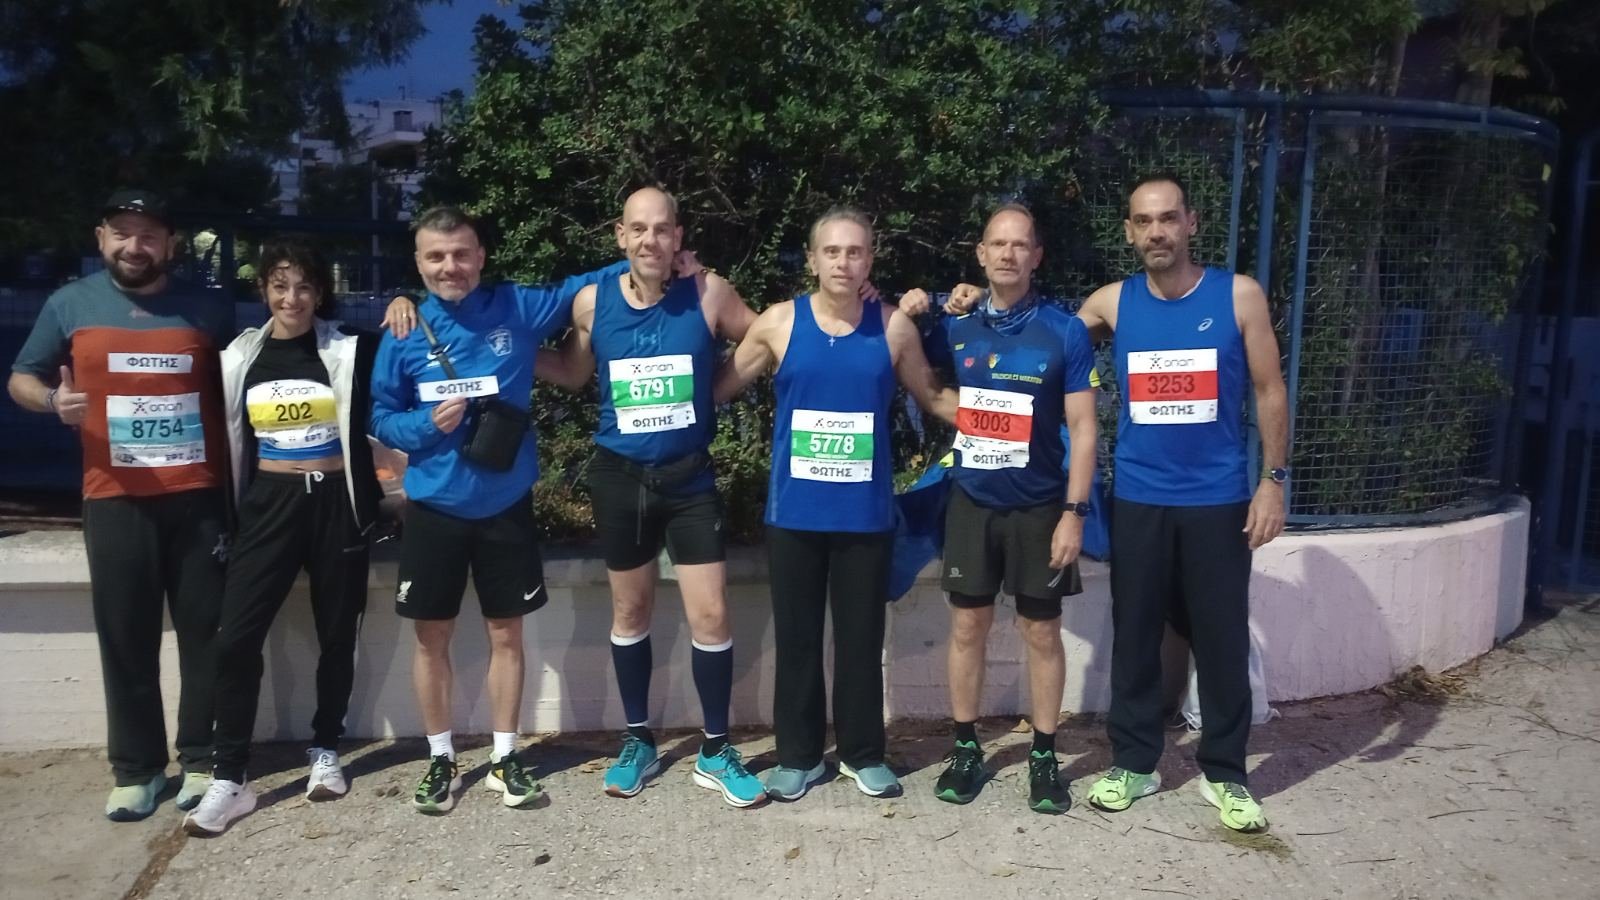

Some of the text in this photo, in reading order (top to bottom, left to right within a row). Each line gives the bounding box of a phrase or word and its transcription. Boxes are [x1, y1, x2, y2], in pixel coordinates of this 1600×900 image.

[126, 357, 179, 368] ΦΩΤΗΣ
[436, 381, 483, 395] ΦΩΤΗΣ
[629, 378, 675, 400] 6791
[1148, 375, 1195, 394] 3253
[275, 402, 313, 423] 202
[1149, 405, 1195, 415] ΦΩΤΗΣ
[131, 419, 184, 439] 8754
[632, 415, 675, 428] ΦΩΤΗΣ
[970, 411, 1012, 434] 3003
[809, 433, 855, 454] 5778
[972, 454, 1013, 465] ΦΩΤΗΣ
[809, 466, 853, 477] ΦΩΤΗΣ
